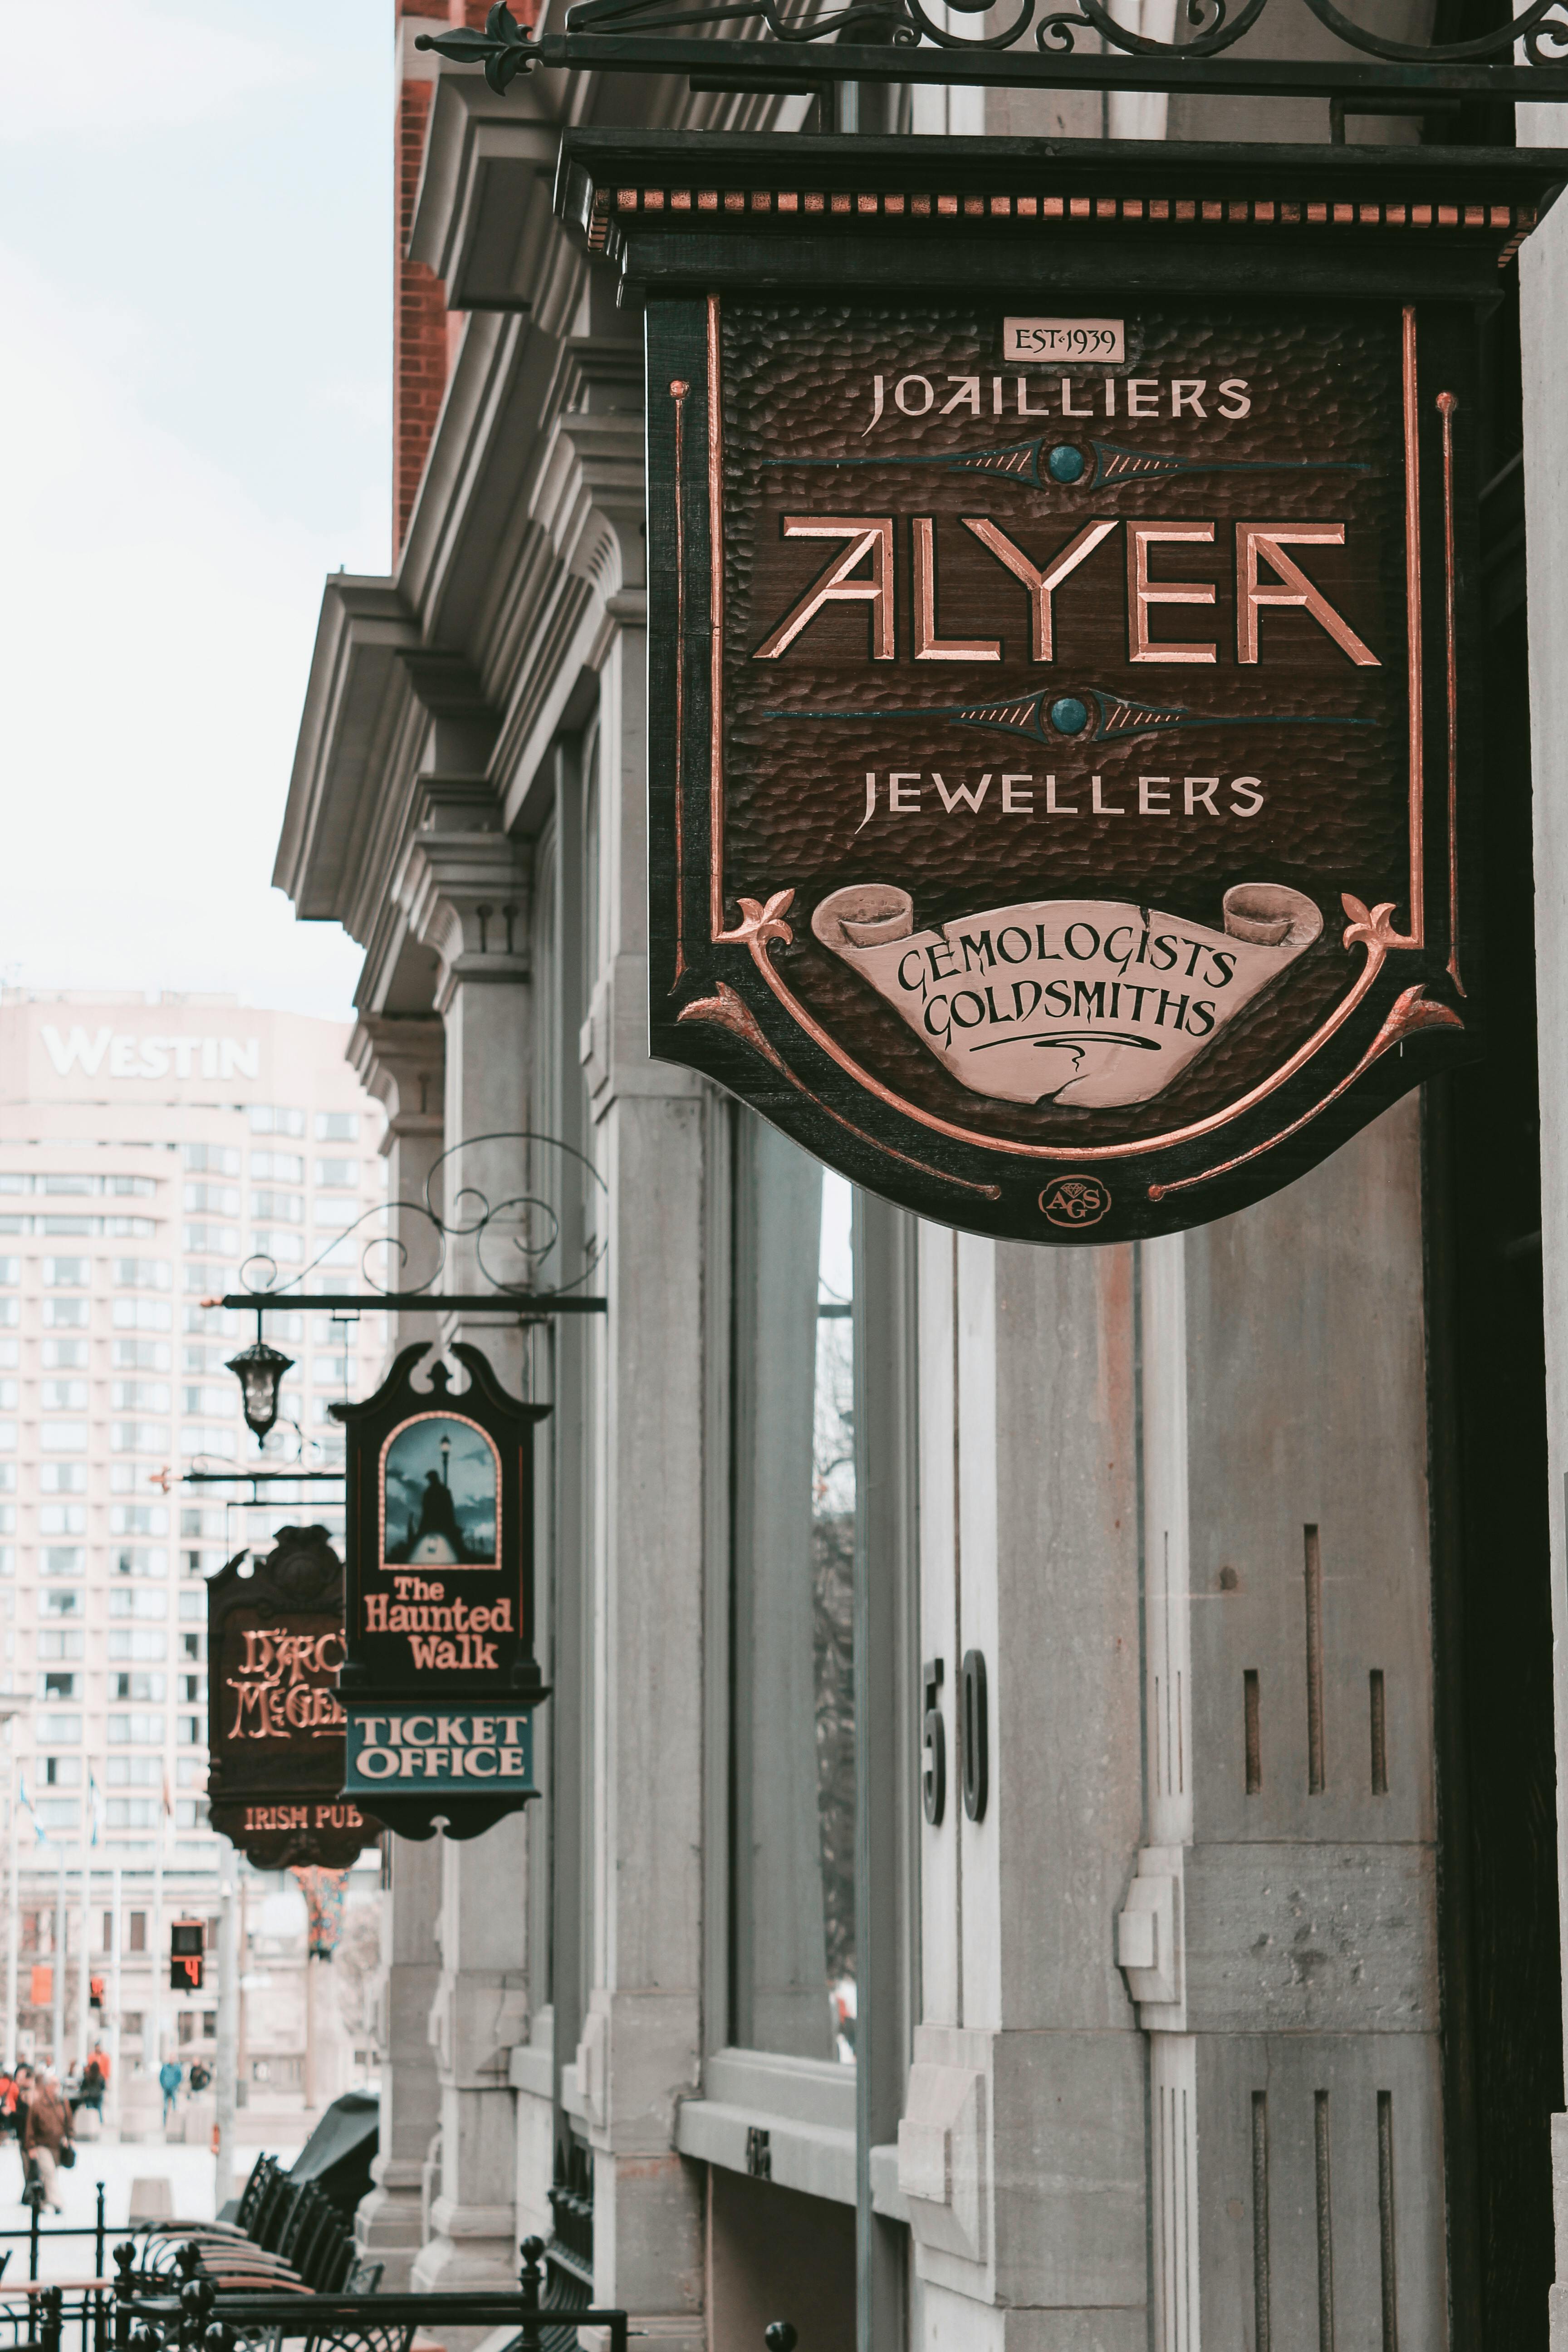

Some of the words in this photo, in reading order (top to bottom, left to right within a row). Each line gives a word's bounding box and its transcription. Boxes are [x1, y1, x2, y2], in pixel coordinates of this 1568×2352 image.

[861, 374, 1252, 437] JOAILLIERS
[752, 516, 1382, 666] ALYEA
[855, 772, 1264, 834] JEWELLERS
[897, 922, 1237, 1004] GEMOLOGISTS
[923, 980, 1217, 1051] GOLDSMITHS
[40, 1024, 260, 1080] WESTIN
[1045, 1189, 1101, 1219] AGS
[393, 1576, 445, 1601] The
[364, 1593, 514, 1633] Haunted
[407, 1634, 500, 1670] Walk
[354, 1715, 528, 1747] TICKET
[356, 1746, 525, 1779] OFFICE
[244, 1805, 309, 1831] IRISH
[315, 1804, 363, 1829] PUB
